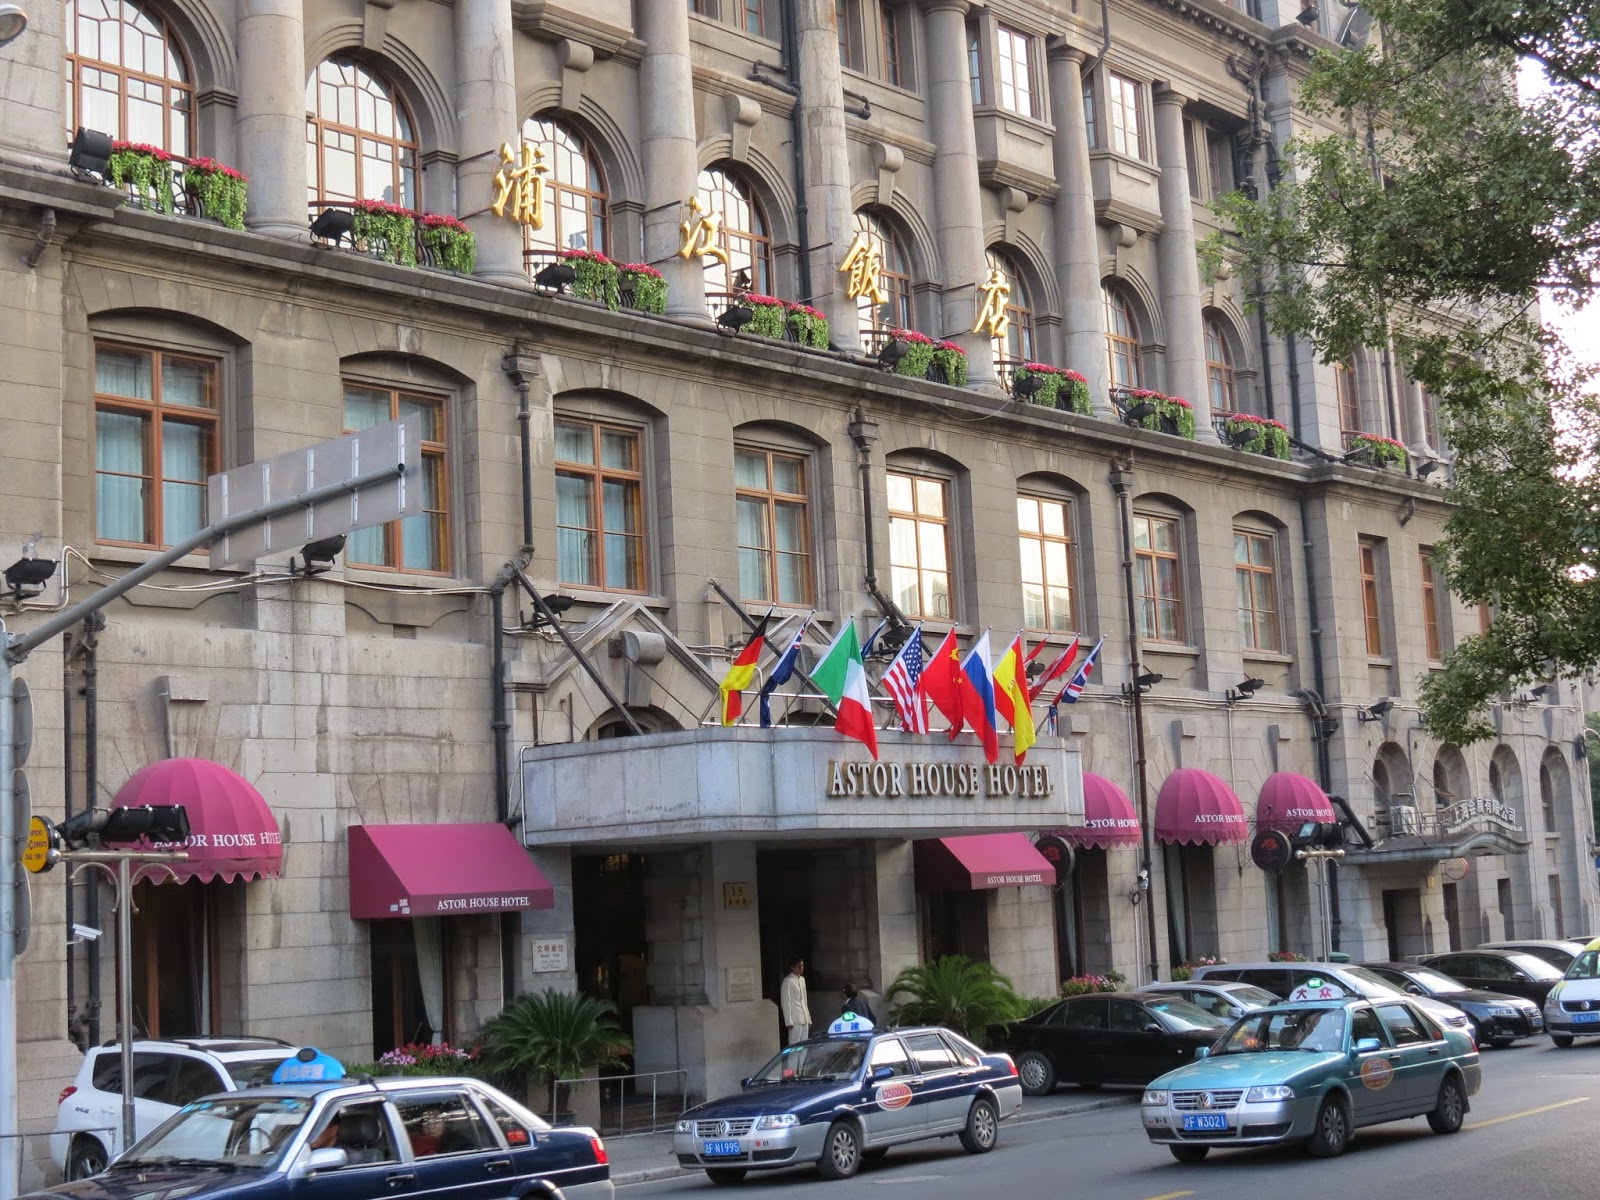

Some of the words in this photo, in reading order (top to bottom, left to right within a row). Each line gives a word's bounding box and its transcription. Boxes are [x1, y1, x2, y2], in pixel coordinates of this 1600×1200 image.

[829, 761, 905, 796] ASTOR
[909, 762, 980, 796] HOUSE
[987, 763, 1056, 797] HOTEL
[1194, 814, 1224, 823] ASTOR
[1285, 808, 1314, 817] ASTOR
[212, 833, 257, 847] HOUSE
[986, 876, 1005, 884] ASTOR
[1006, 875, 1024, 884] HOUSE
[1024, 874, 1042, 883] HOTEL
[437, 900, 468, 910] ASTOR
[469, 898, 500, 907] HOUSE
[501, 897, 530, 906] HOTEL
[1296, 986, 1332, 1000] 大众
